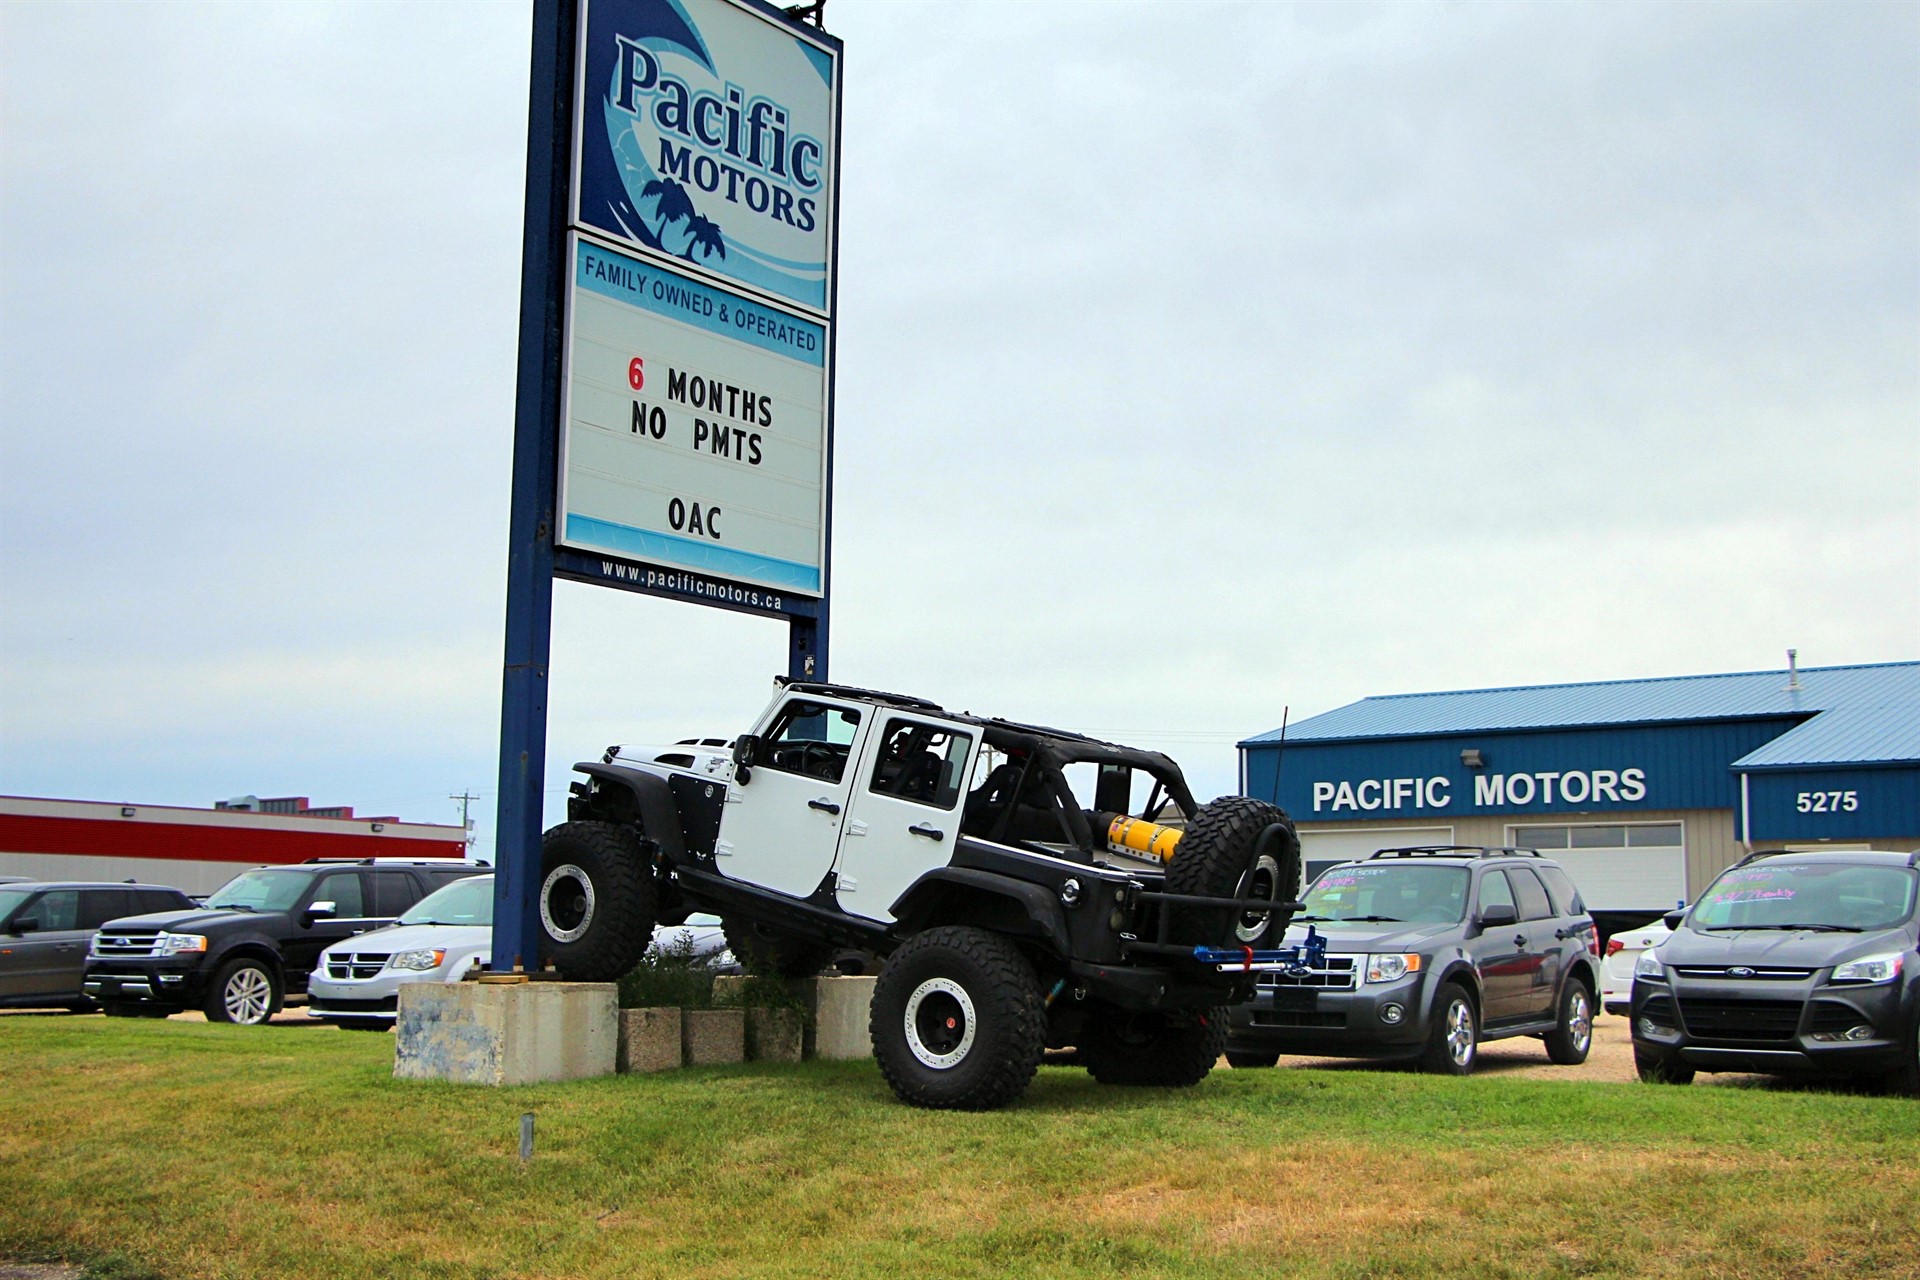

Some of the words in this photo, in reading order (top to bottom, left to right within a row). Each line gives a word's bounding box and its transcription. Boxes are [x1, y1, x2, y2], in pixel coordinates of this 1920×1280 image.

[615, 35, 821, 189] Pacific
[657, 137, 816, 232] MOTORS
[585, 255, 648, 294] FAMILY
[653, 280, 713, 317] OWNED
[718, 303, 729, 323] &
[735, 309, 816, 351] OPERATED
[628, 357, 644, 391] 6
[668, 368, 772, 428] MONTHS
[631, 400, 667, 440] NO
[693, 418, 763, 465] PMTS
[668, 497, 722, 540] OAC
[602, 561, 781, 610] www.pacificmotors.ca
[1313, 776, 1451, 812] PACIFIC
[1474, 768, 1646, 806] MOTORS
[1796, 791, 1858, 813] 5275
